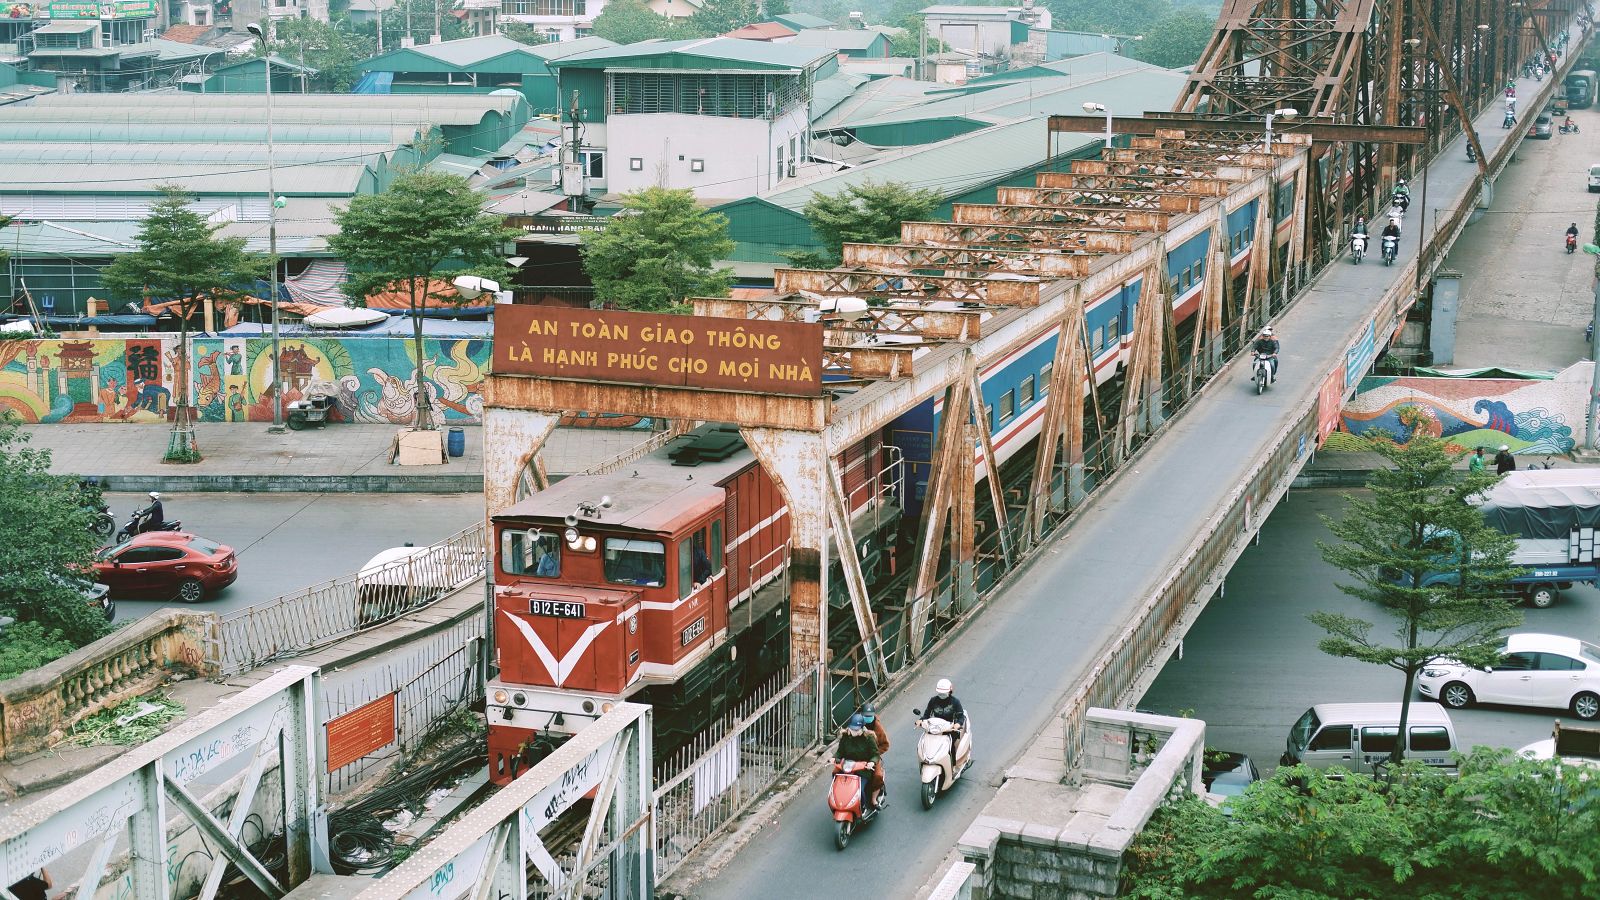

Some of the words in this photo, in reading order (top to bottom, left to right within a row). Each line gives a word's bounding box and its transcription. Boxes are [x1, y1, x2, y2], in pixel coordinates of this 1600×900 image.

[528, 319, 558, 336] AN
[570, 318, 628, 341] TOÀN
[640, 322, 695, 345] GIAO
[706, 327, 781, 350] THÔNG
[509, 341, 534, 363] LÀ
[543, 348, 598, 369] HẠNH
[607, 347, 658, 373] PHÚC
[668, 356, 708, 375] CHO
[718, 360, 760, 383] MỌI
[769, 358, 813, 382] NHÀ
